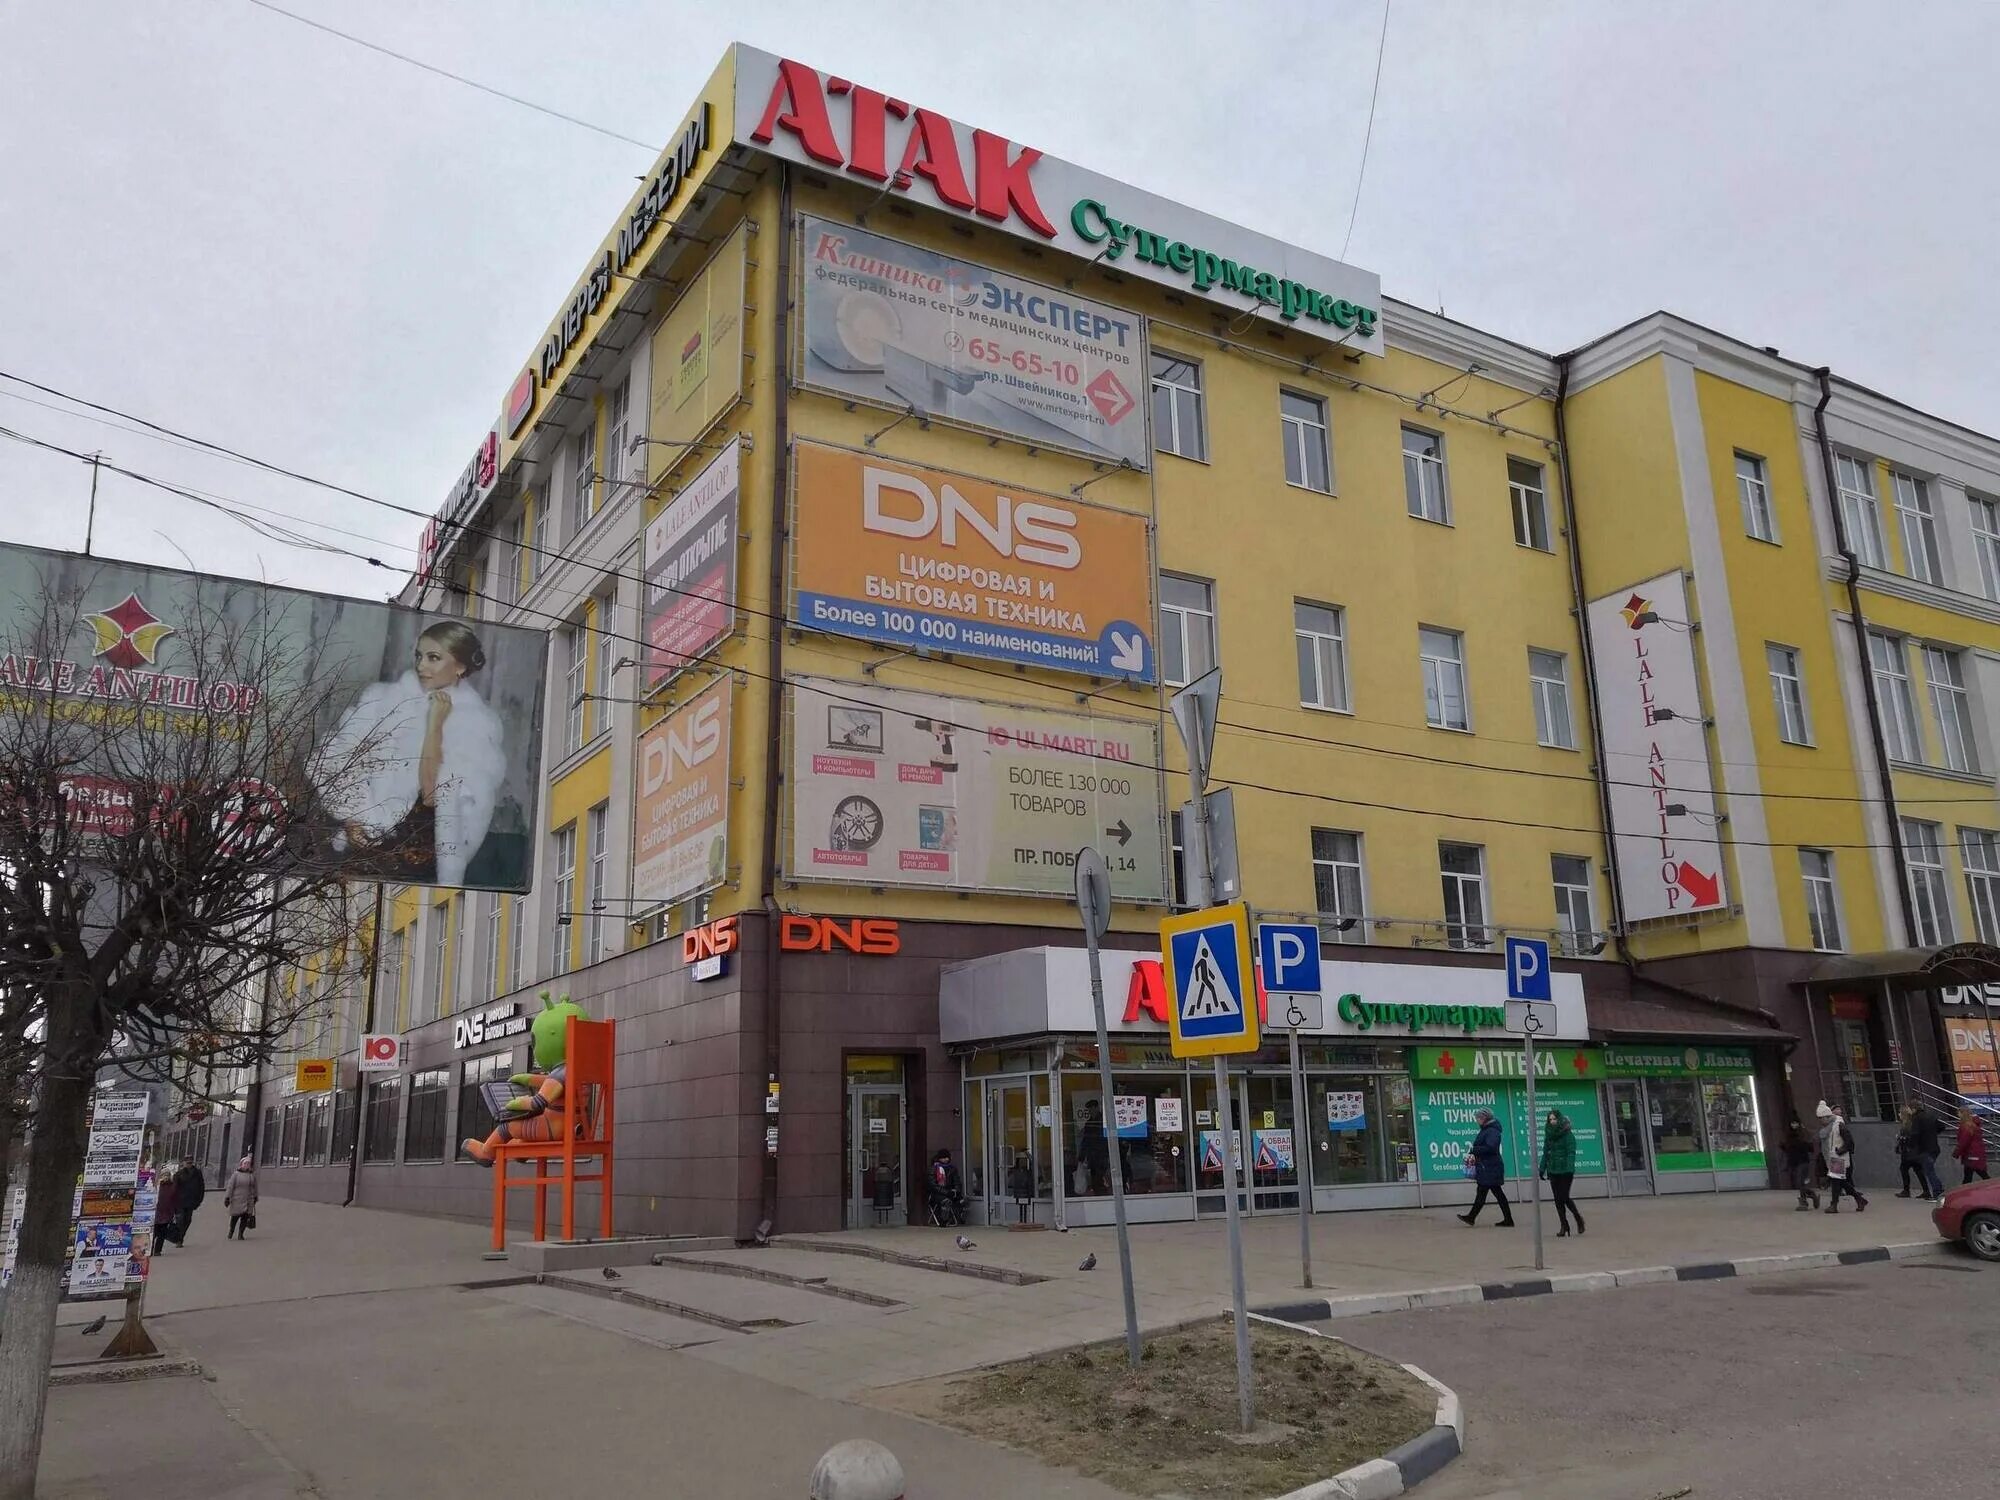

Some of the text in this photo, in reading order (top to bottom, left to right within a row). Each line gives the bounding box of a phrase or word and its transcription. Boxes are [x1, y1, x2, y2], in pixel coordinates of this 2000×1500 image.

[750, 57, 1377, 338] АТАК Супермаркет
[541, 101, 711, 388] ГАЛЕРЕЯ МЕБЕЛИ
[814, 231, 944, 294] Клиника
[814, 264, 1131, 366] федеральная сеть медицинских центров
[981, 280, 1131, 347] ЭКСПЕРТ
[967, 337, 1080, 386] 65-65-10
[982, 367, 1003, 385] пр.
[1017, 395, 1105, 425] www.mrtexpert.ru
[863, 465, 1083, 570] DNS
[650, 558, 678, 607] СКОРО
[679, 513, 729, 583] ОТКРЫТИЕ
[899, 552, 1056, 602] ЦИФРОВАЯ И
[865, 574, 1087, 634] БЫТОВАЯ ТЕХНИКА
[813, 599, 1100, 665] Более 100 000 наименований!
[77, 663, 262, 716] ANTILOP
[642, 694, 721, 798] DNS
[1016, 728, 1131, 761] ULMART.RU
[1009, 766, 1131, 796] БОЛЕЕ 130 000
[1632, 636, 1682, 911] LALE ANTILOP
[652, 782, 699, 823] ЦИФРОВАЯ
[1010, 792, 1087, 816] ТОВАРОВ
[641, 796, 720, 852] БЫТОВАЯ ТЕХНИКА
[817, 852, 862, 862] АВТОТОВАРЫ
[902, 853, 929, 861] ТОВАРЫ
[1014, 848, 1136, 872] ПР. ПОБ, 14
[683, 916, 737, 964] DNS
[780, 914, 901, 955] DNS
[1338, 992, 1506, 1033] Супермарк
[1940, 981, 2000, 1007] DNS
[454, 1013, 484, 1049] DNS
[1951, 1028, 1996, 1051] DNS
[1473, 1051, 1559, 1076] АПТЕКА
[1604, 1050, 1753, 1067] Печатная Лавка
[1428, 1088, 1496, 1106] АПТЕЧНЫЙ
[1443, 1108, 1480, 1124] ПУНК
[1267, 1136, 1291, 1145] ОБВАЛ
[1277, 1144, 1291, 1152] ЦЕН
